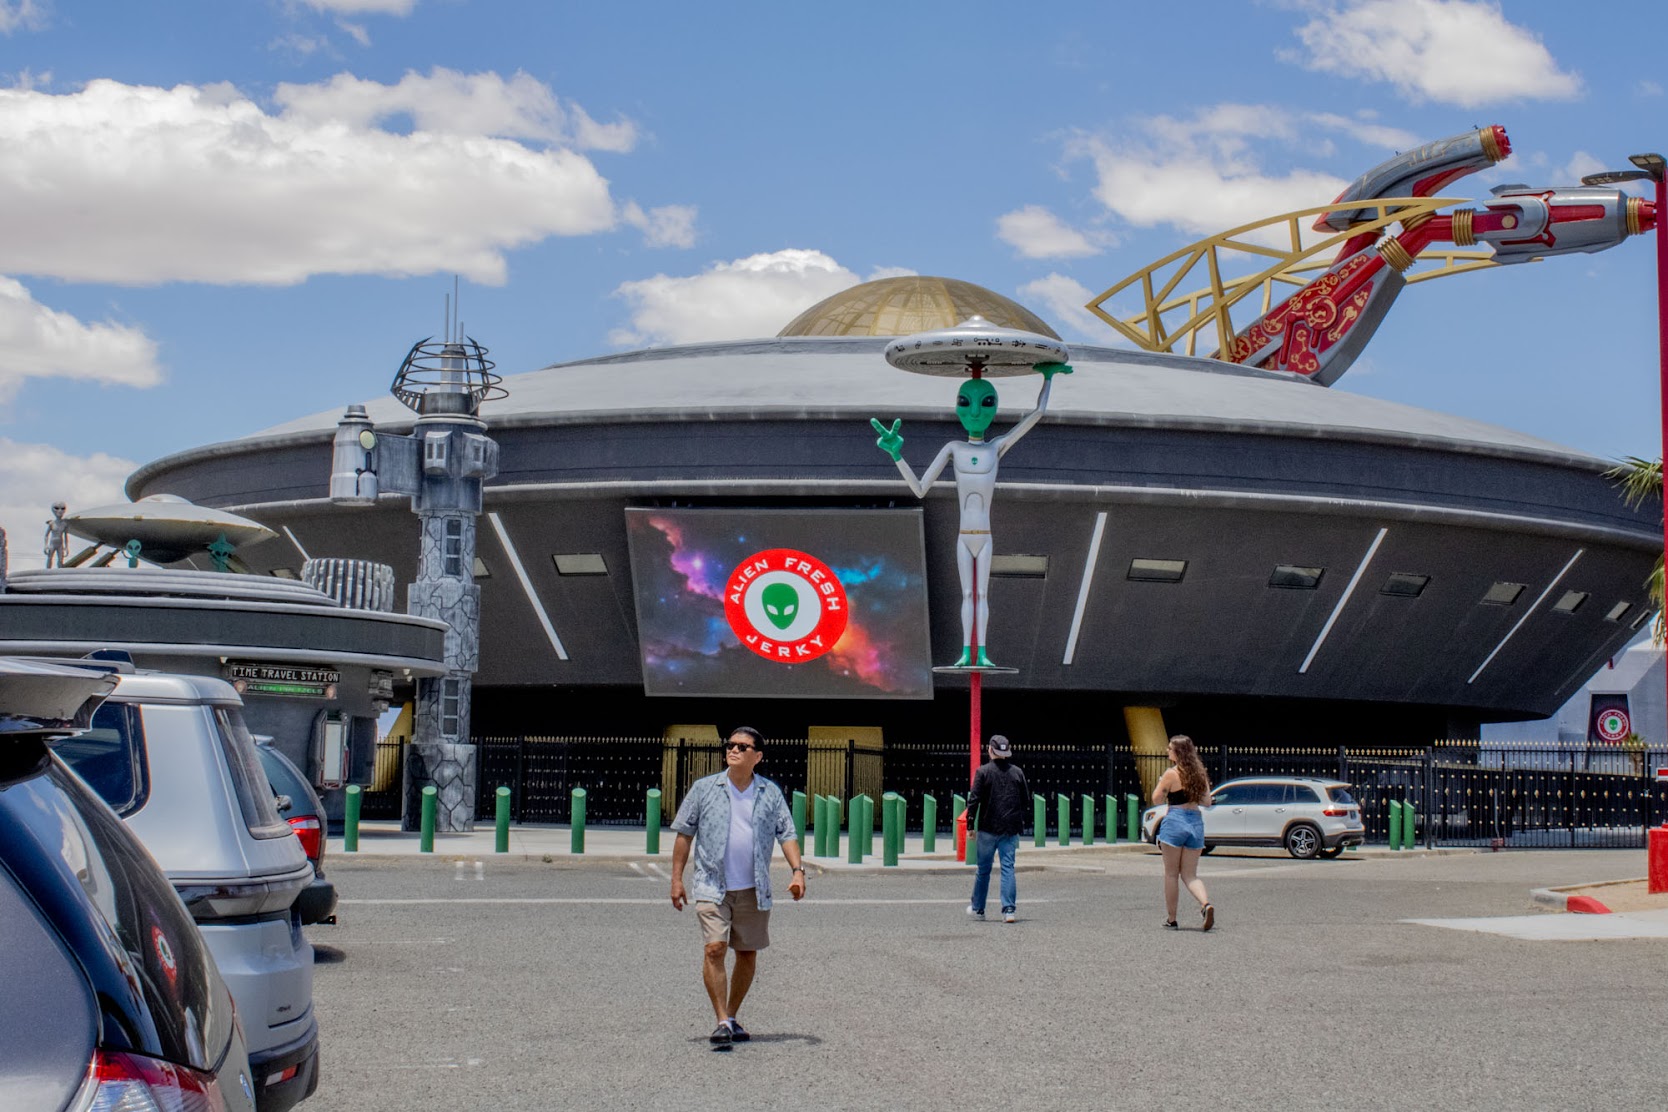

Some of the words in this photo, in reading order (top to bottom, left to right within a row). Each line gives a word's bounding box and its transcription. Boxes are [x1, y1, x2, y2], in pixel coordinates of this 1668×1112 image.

[730, 559, 769, 604] ALIEN
[784, 557, 841, 611] FRESH
[746, 634, 823, 658] JERKY
[232, 667, 259, 678] TIME
[261, 669, 298, 680] TRAVEL
[300, 671, 339, 682] STATION
